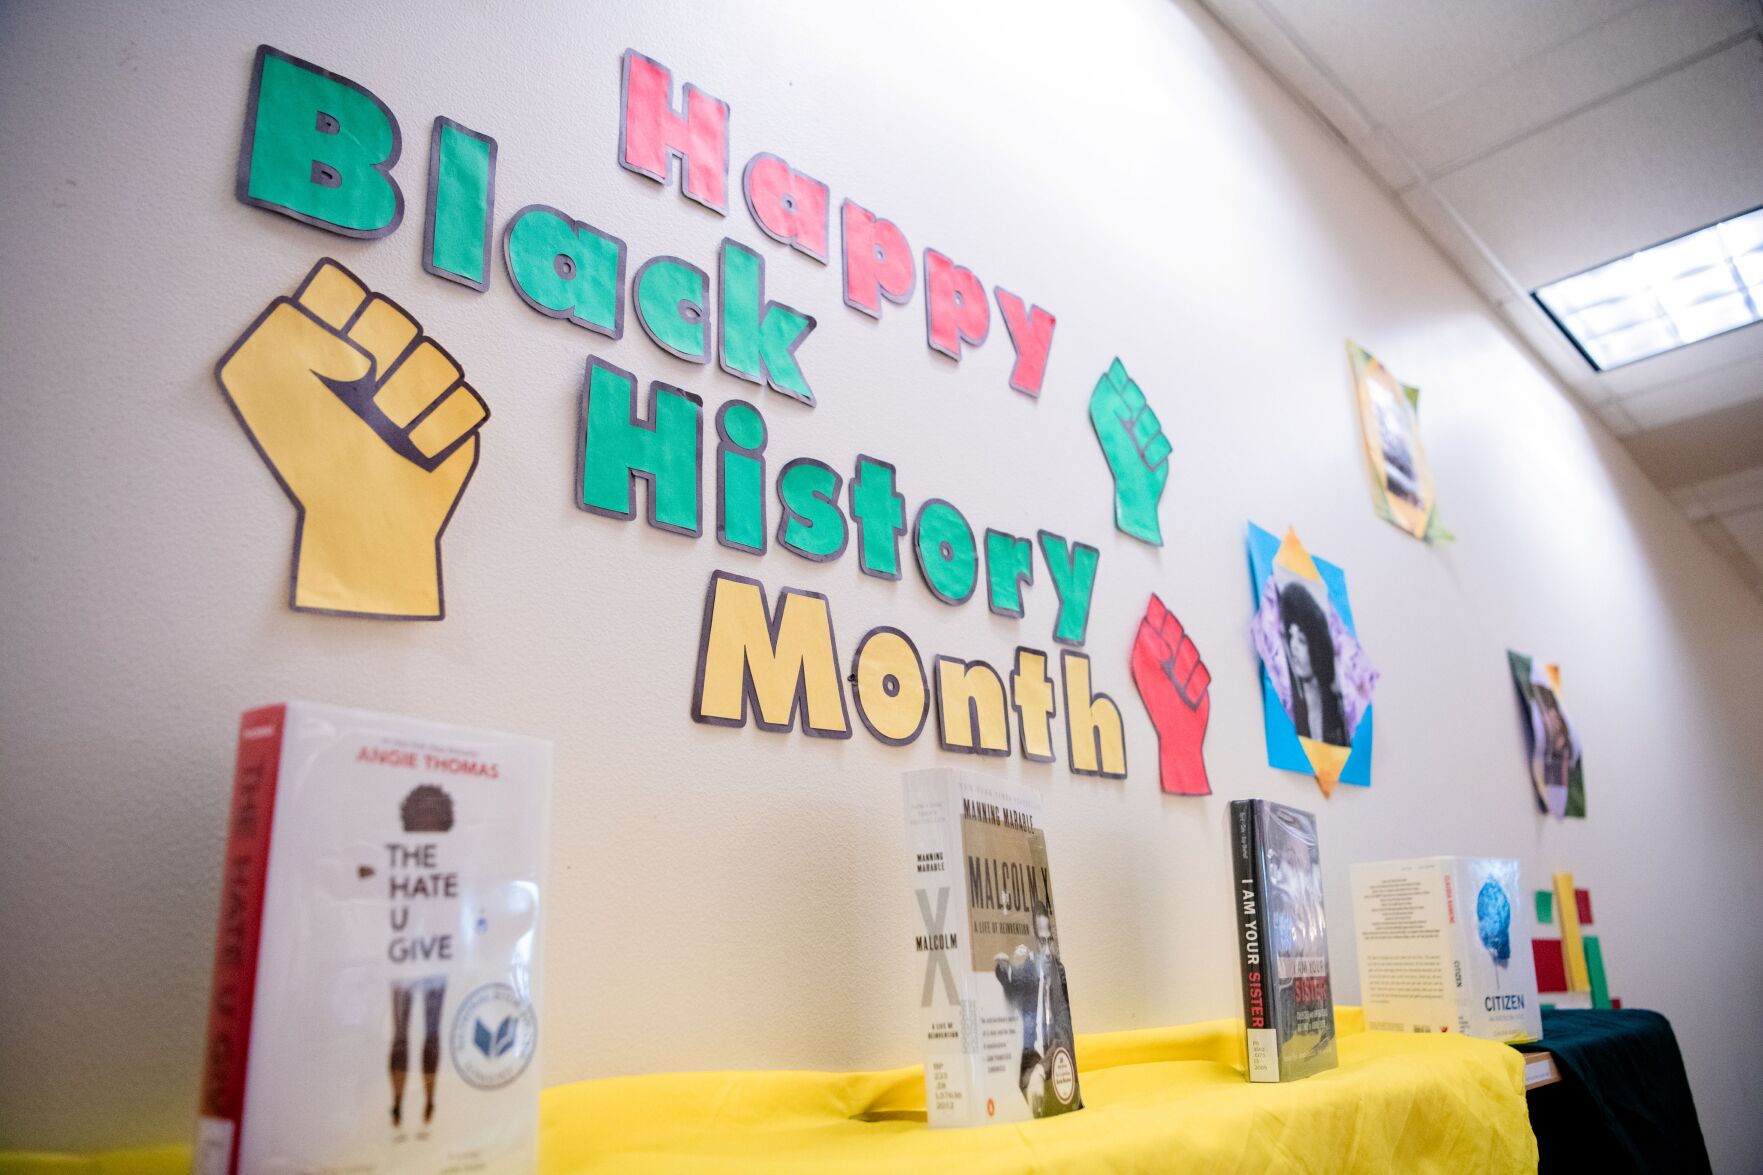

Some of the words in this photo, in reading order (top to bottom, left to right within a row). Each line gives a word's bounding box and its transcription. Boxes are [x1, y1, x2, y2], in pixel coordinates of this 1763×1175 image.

[236, 44, 817, 407] Black
[618, 47, 1056, 400] Happy
[575, 354, 1100, 646] History
[691, 570, 1127, 779] Month
[356, 746, 418, 769] ANGIE
[424, 753, 500, 779] THOMAS
[963, 798, 1000, 826] MANNING
[1003, 808, 1035, 835] MARABLE
[385, 843, 438, 868] THE
[916, 851, 944, 862] MANNING
[916, 862, 945, 873] MARABLE
[389, 872, 459, 898] HATE
[968, 856, 1039, 914] MALCOLM
[1041, 867, 1053, 915] X
[1242, 890, 1256, 915] AM
[390, 907, 409, 931] U
[388, 935, 454, 964] GIVE
[916, 933, 958, 951] MALCOLM
[1245, 920, 1260, 965] YOUR
[1249, 971, 1265, 1028] SISTER
[1485, 994, 1525, 1012] CITIZEN
